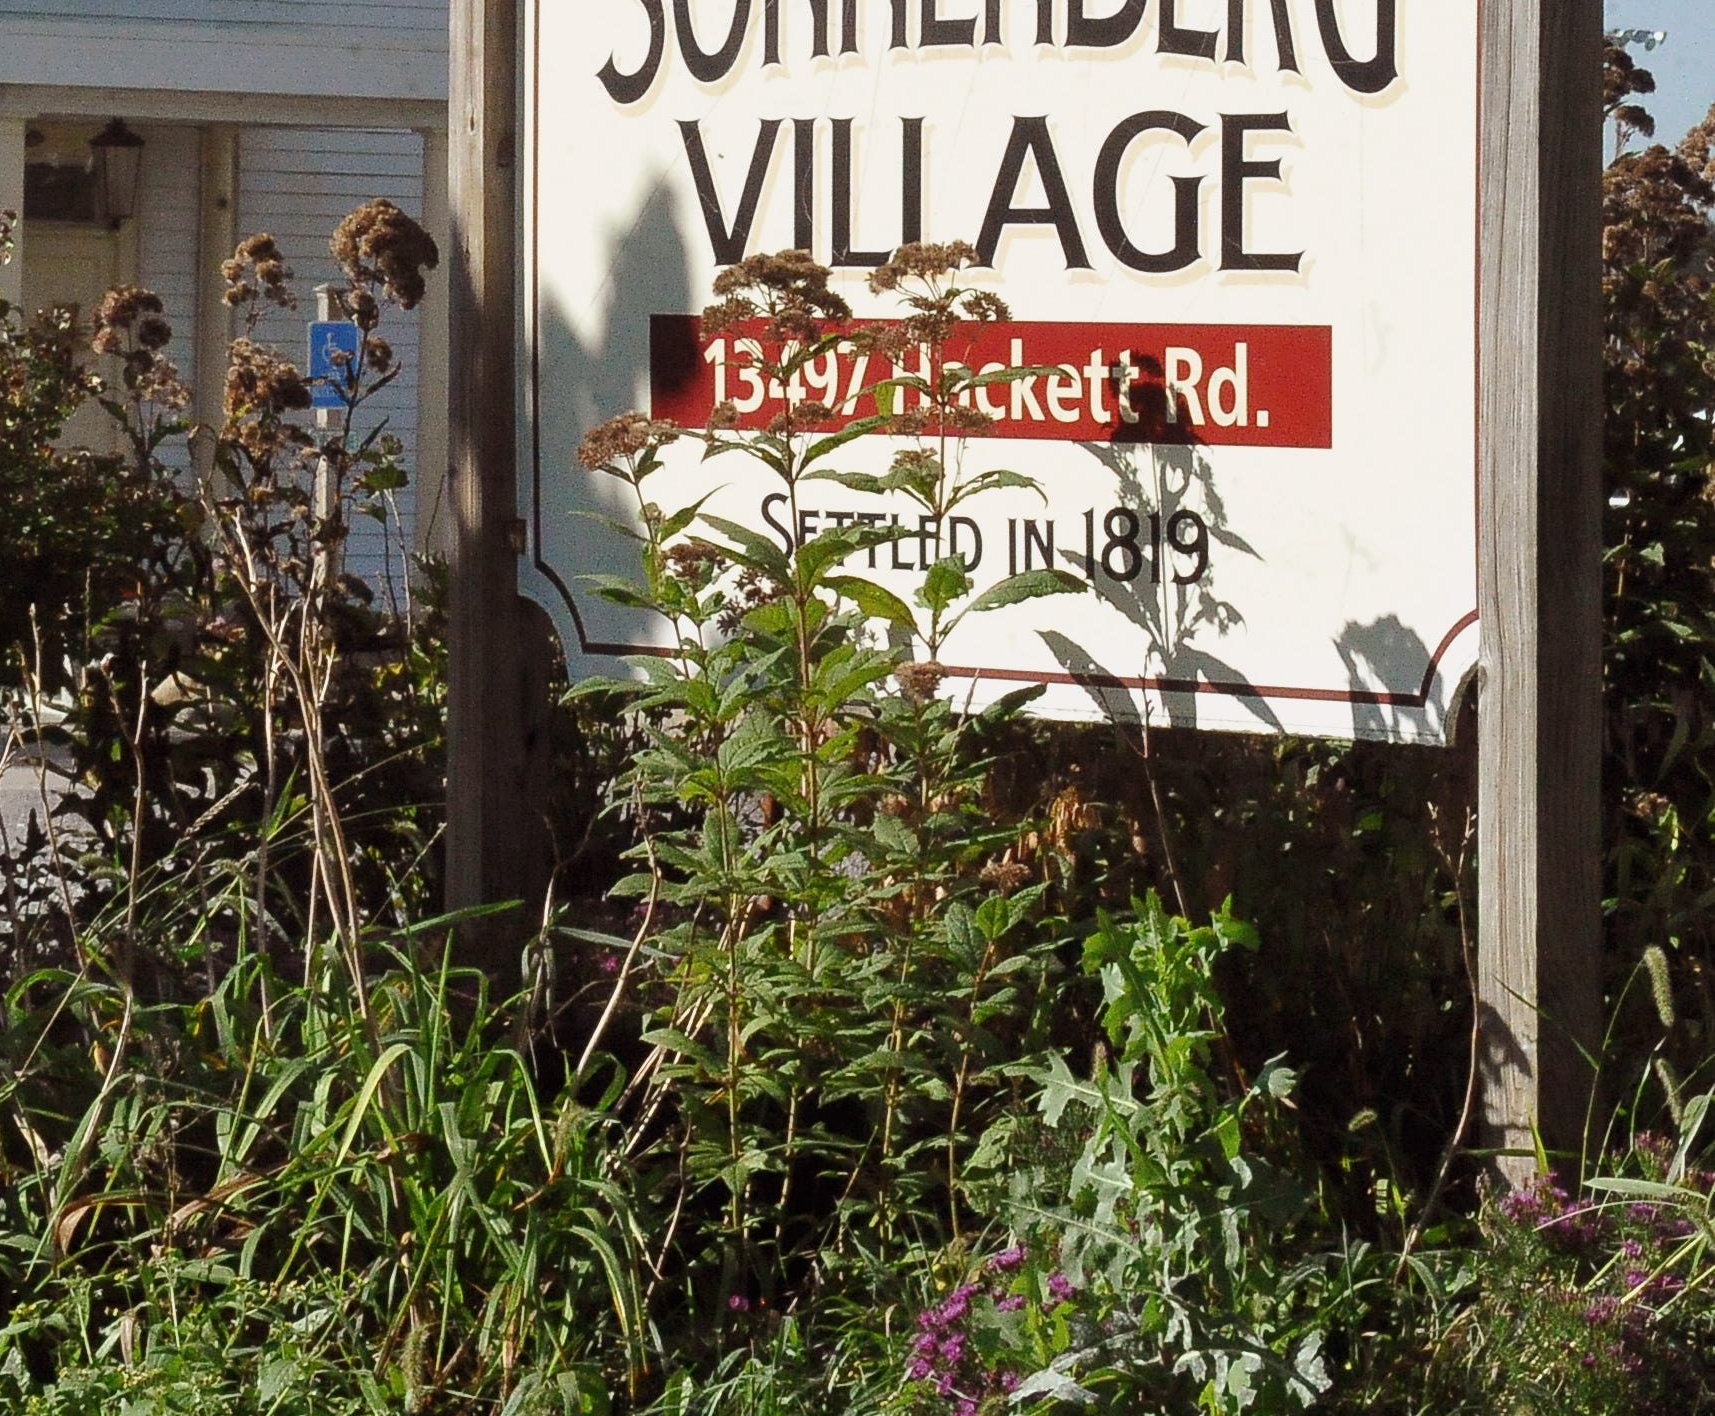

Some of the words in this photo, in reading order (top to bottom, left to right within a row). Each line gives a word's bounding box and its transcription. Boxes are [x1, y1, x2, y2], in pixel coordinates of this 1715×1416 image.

[675, 109, 1306, 274] VILLAGE
[703, 337, 870, 416] 13497
[1164, 341, 1270, 427] Rd.
[1007, 518, 1055, 577] IN
[1082, 506, 1210, 585] 1819
